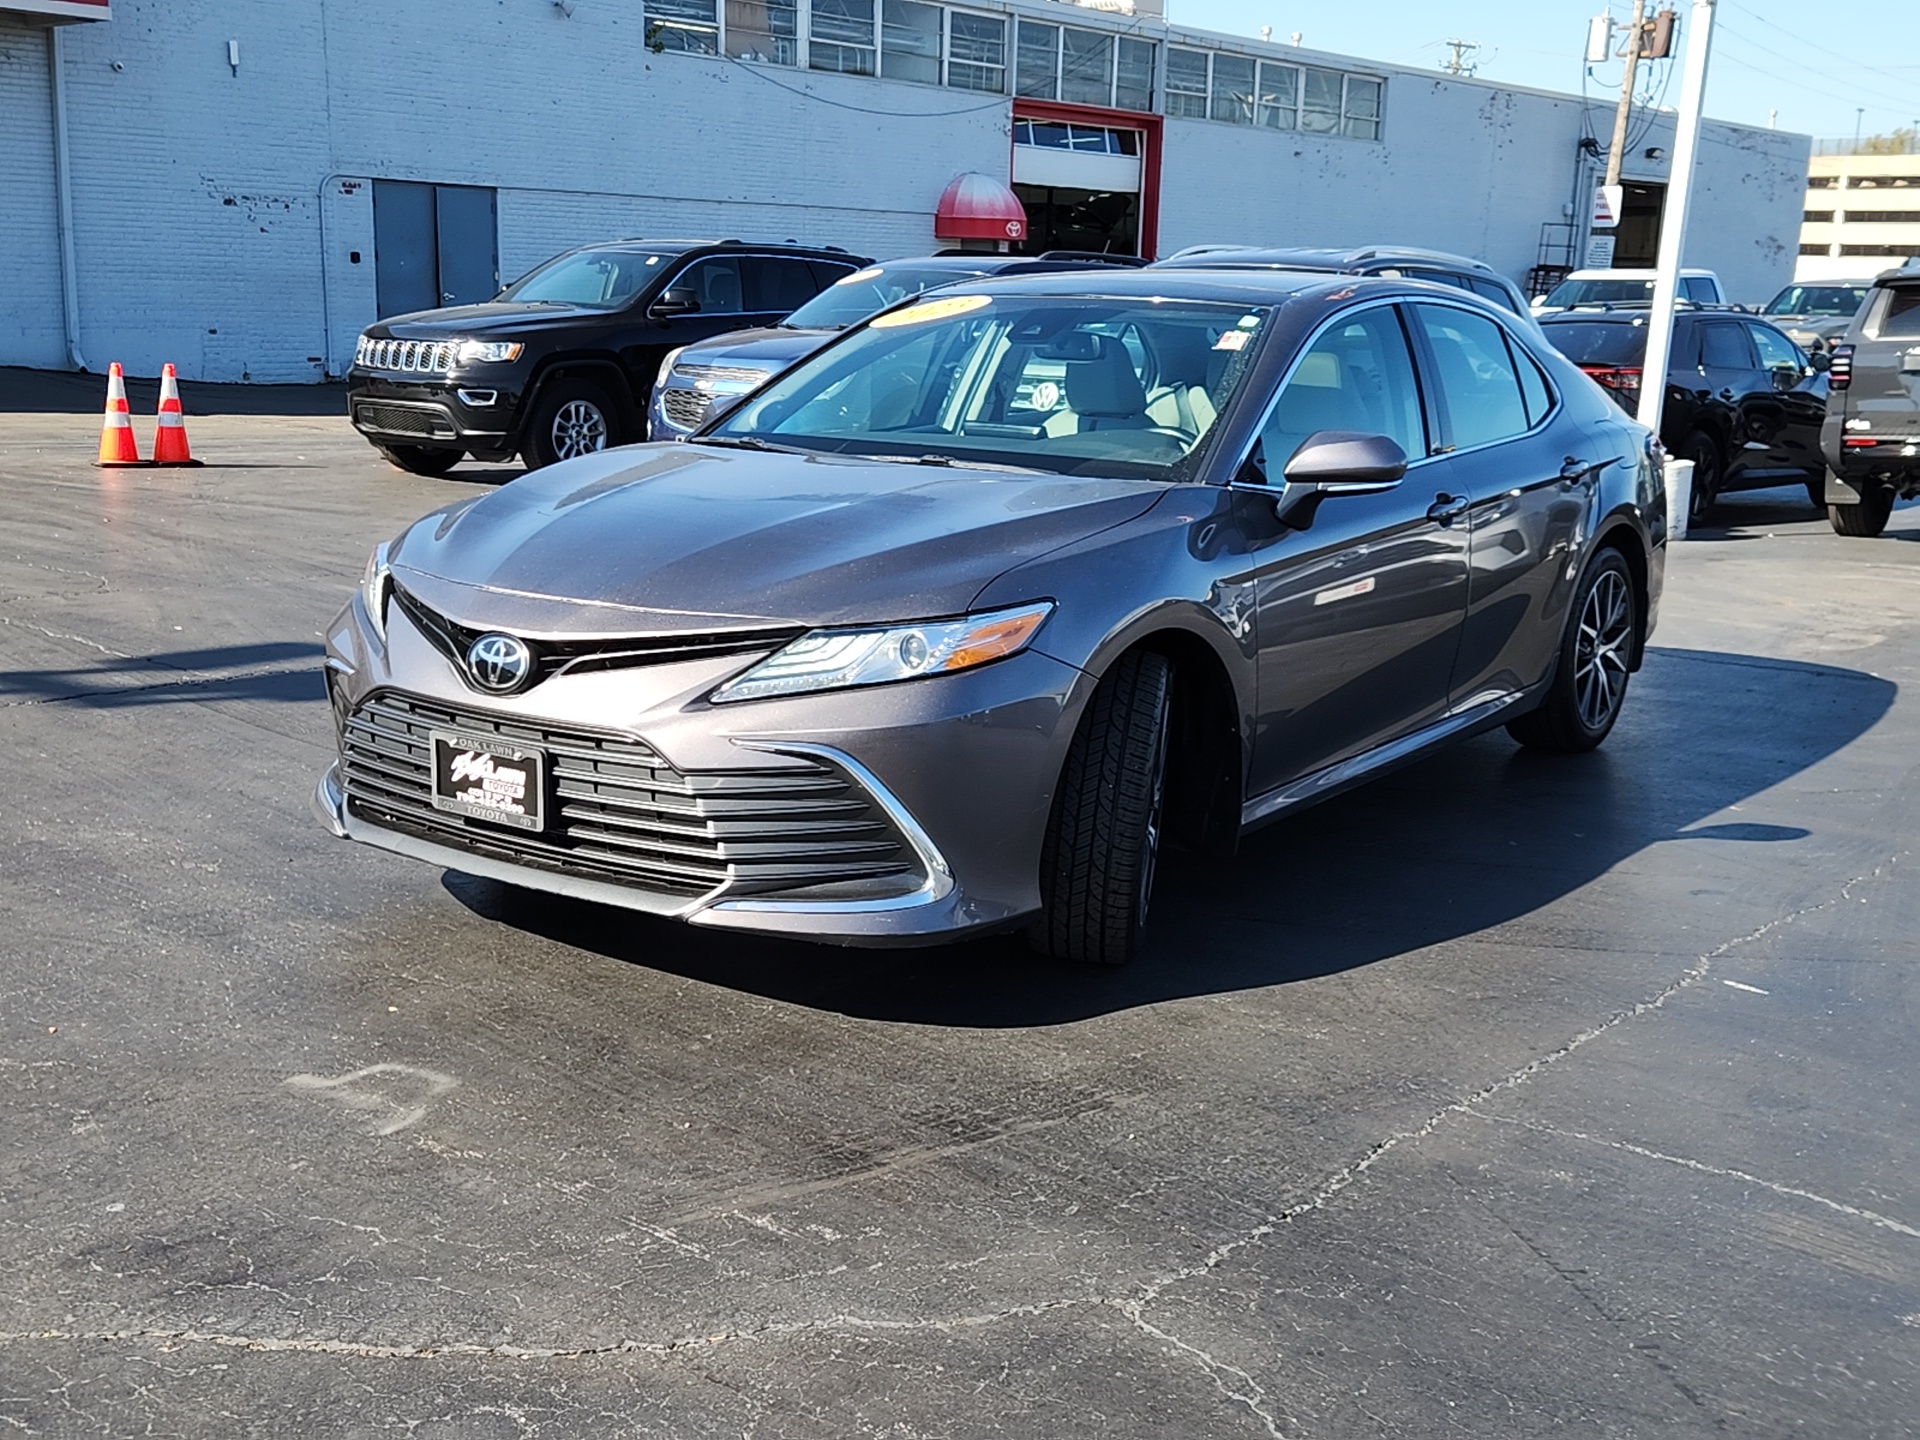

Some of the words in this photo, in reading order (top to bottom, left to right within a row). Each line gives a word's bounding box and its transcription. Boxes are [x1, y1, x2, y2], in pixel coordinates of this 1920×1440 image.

[460, 738, 481, 750] OAK
[483, 742, 513, 757] LAWN
[488, 780, 519, 794] TOYOTA
[466, 806, 508, 822] TOYOTA
